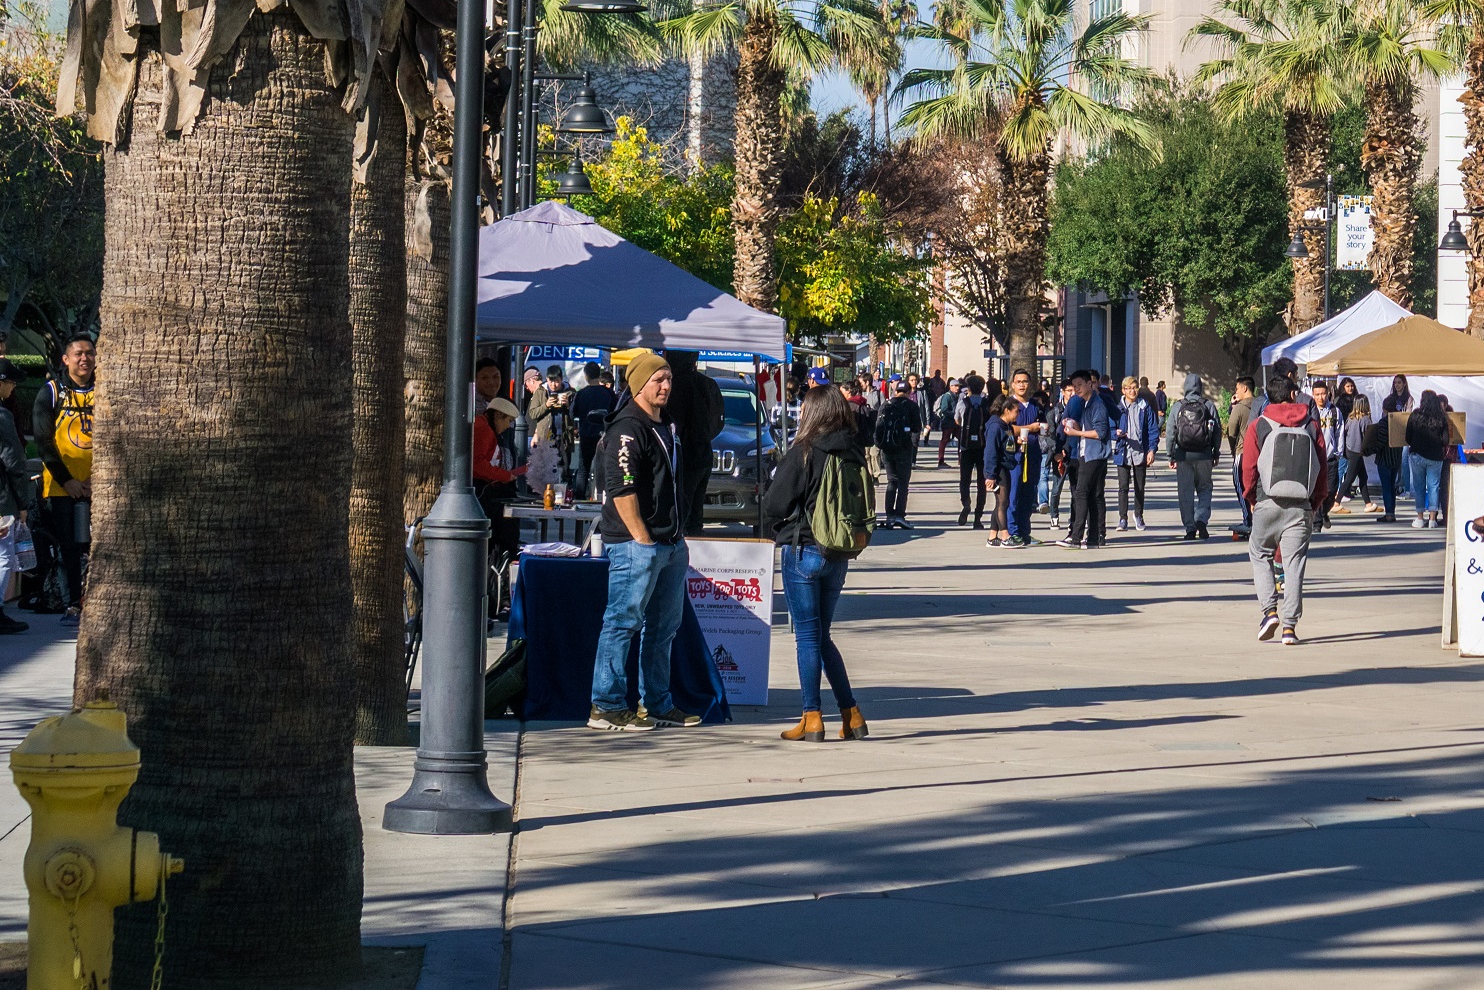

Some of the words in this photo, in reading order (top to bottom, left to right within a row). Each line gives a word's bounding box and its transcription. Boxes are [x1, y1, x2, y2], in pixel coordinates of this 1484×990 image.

[1345, 224, 1368, 232] Share
[1346, 242, 1367, 250] story
[531, 345, 584, 359] DENTS
[690, 580, 711, 592] TOYS
[715, 583, 731, 594] FOR
[736, 585, 758, 597] TOTS
[719, 628, 744, 636] Packaging
